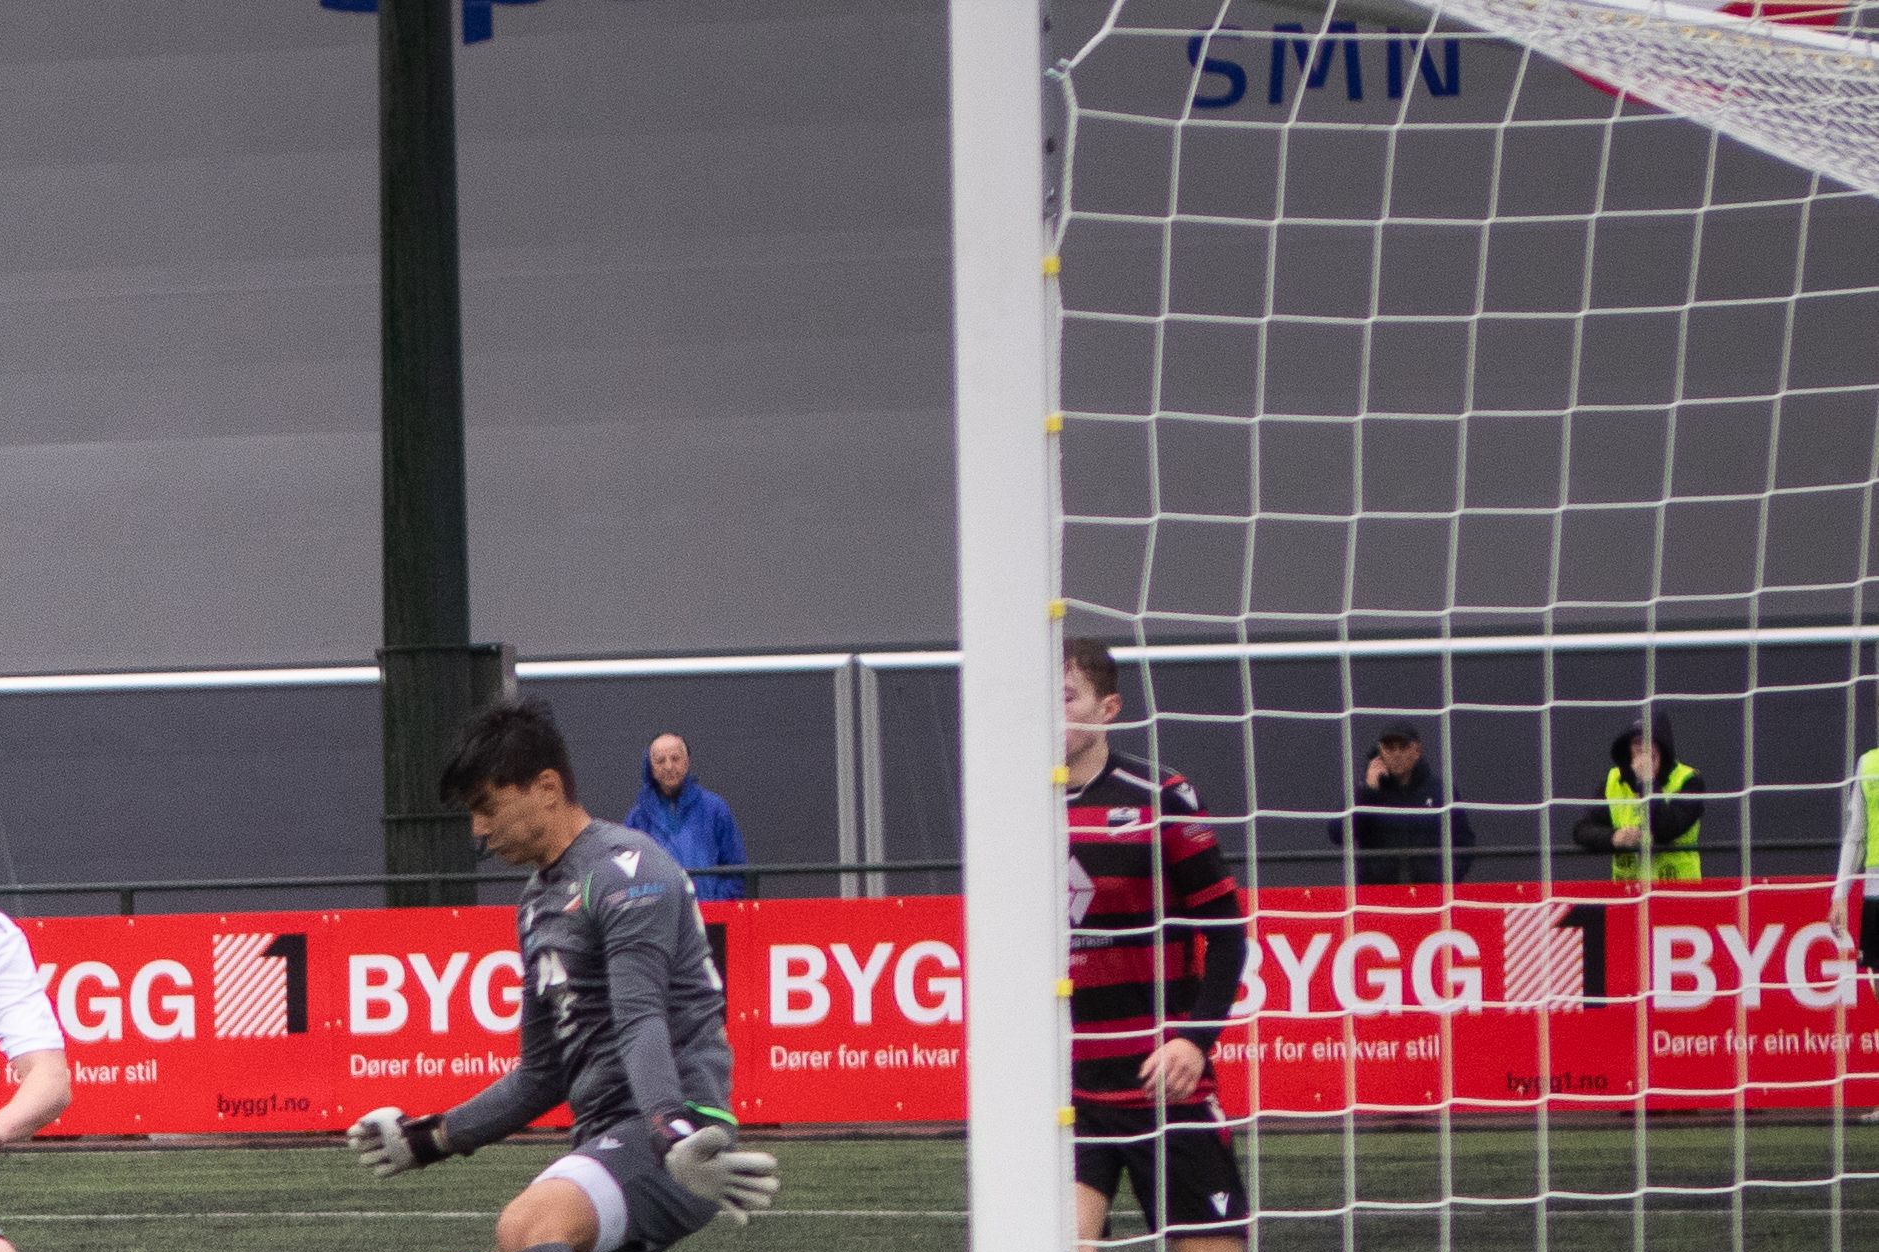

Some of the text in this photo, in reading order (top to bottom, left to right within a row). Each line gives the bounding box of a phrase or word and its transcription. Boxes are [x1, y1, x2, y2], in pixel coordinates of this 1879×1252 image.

[1186, 22, 1460, 109] SMN
[349, 950, 524, 1034] BYG
[770, 940, 963, 1026] BYG
[1229, 930, 1483, 1017] BYGG
[1652, 922, 1857, 1010] BYG
[38, 959, 196, 1043] GG
[350, 1054, 409, 1077] Dører
[415, 1052, 445, 1077] for
[451, 1053, 484, 1076] ein
[771, 1043, 960, 1070] Dører for ein kvar
[1274, 1035, 1305, 1061] for
[1312, 1036, 1347, 1061] ein
[1351, 1036, 1399, 1061] kvar
[1405, 1033, 1440, 1060] stil
[1653, 1027, 1879, 1056] Dører for ein kvar st
[75, 1060, 120, 1082] kvar
[125, 1059, 158, 1082] stil
[217, 1093, 311, 1117] bygg1.no
